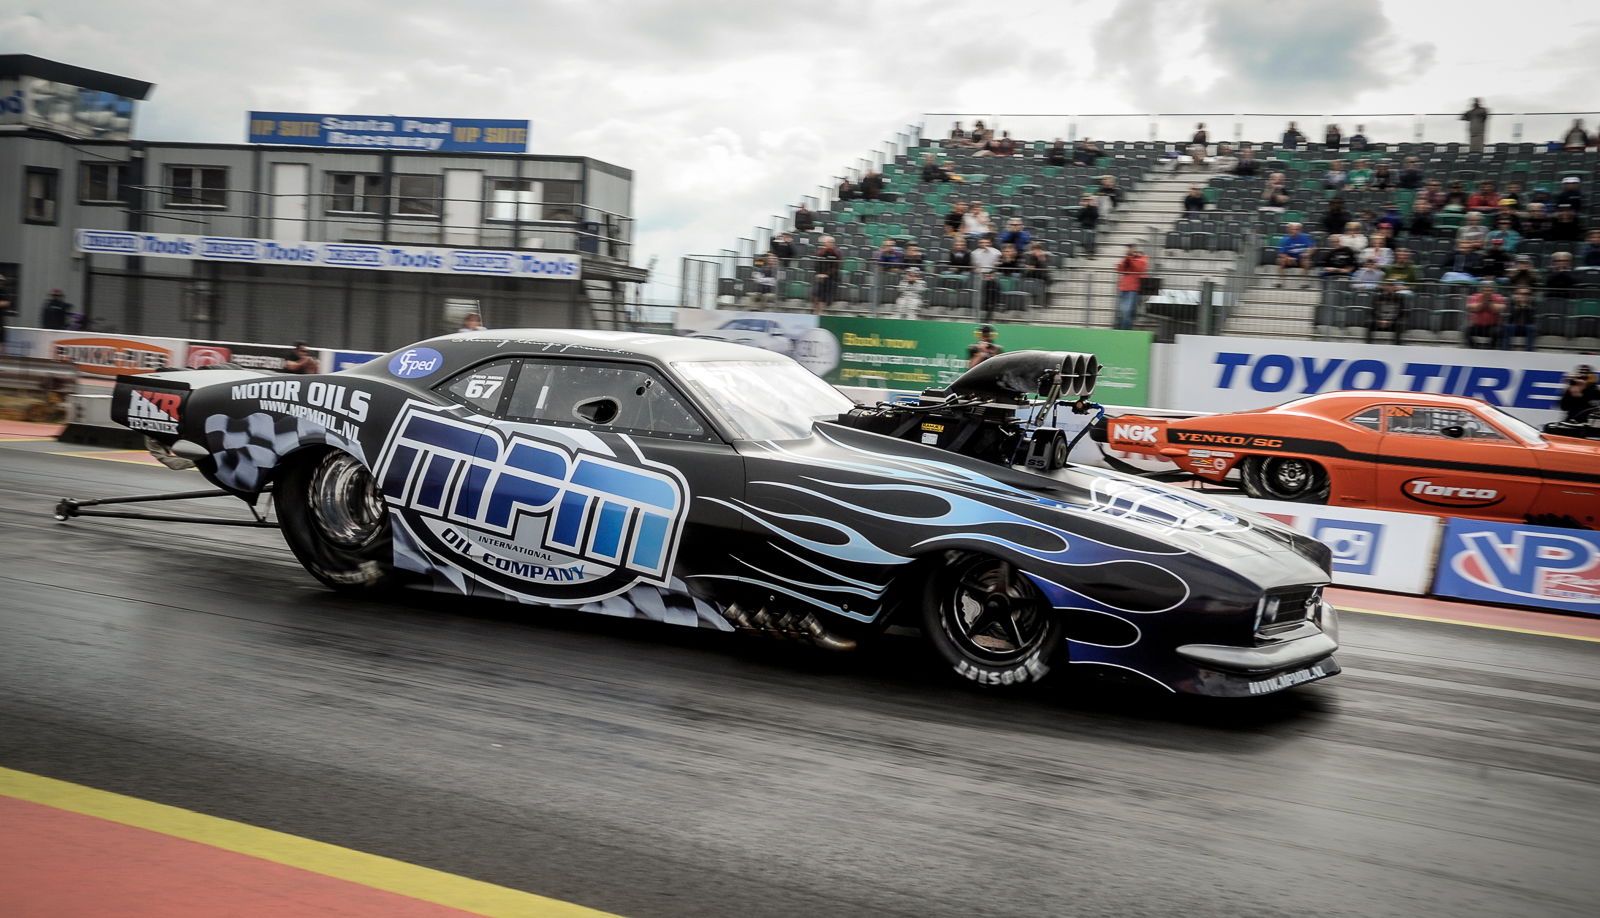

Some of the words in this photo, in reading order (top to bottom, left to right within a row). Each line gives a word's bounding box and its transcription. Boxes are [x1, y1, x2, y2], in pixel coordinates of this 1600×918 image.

[322, 117, 395, 132] Santa
[402, 120, 451, 134] Pod
[327, 132, 444, 150] Raceway
[142, 236, 194, 255] Tools
[262, 243, 316, 262] Tools
[388, 249, 442, 268] Tools
[518, 255, 577, 275] Tools
[843, 332, 879, 347] Book
[884, 338, 918, 349] now
[465, 380, 503, 399] 67
[1214, 352, 1388, 394] TOYO
[1402, 362, 1600, 409] TIRE
[231, 380, 300, 401] MOTOR
[307, 382, 372, 422] OILS
[260, 400, 361, 445] WWW.MPMOIL.NL
[1113, 424, 1159, 443] NGK
[1176, 432, 1284, 448] YENKO/SC
[1411, 480, 1498, 498] Torco
[441, 527, 472, 556] OIL
[482, 552, 586, 582] COMPANY
[478, 535, 553, 562] INTERNATIONAL
[1459, 530, 1598, 596] VP
